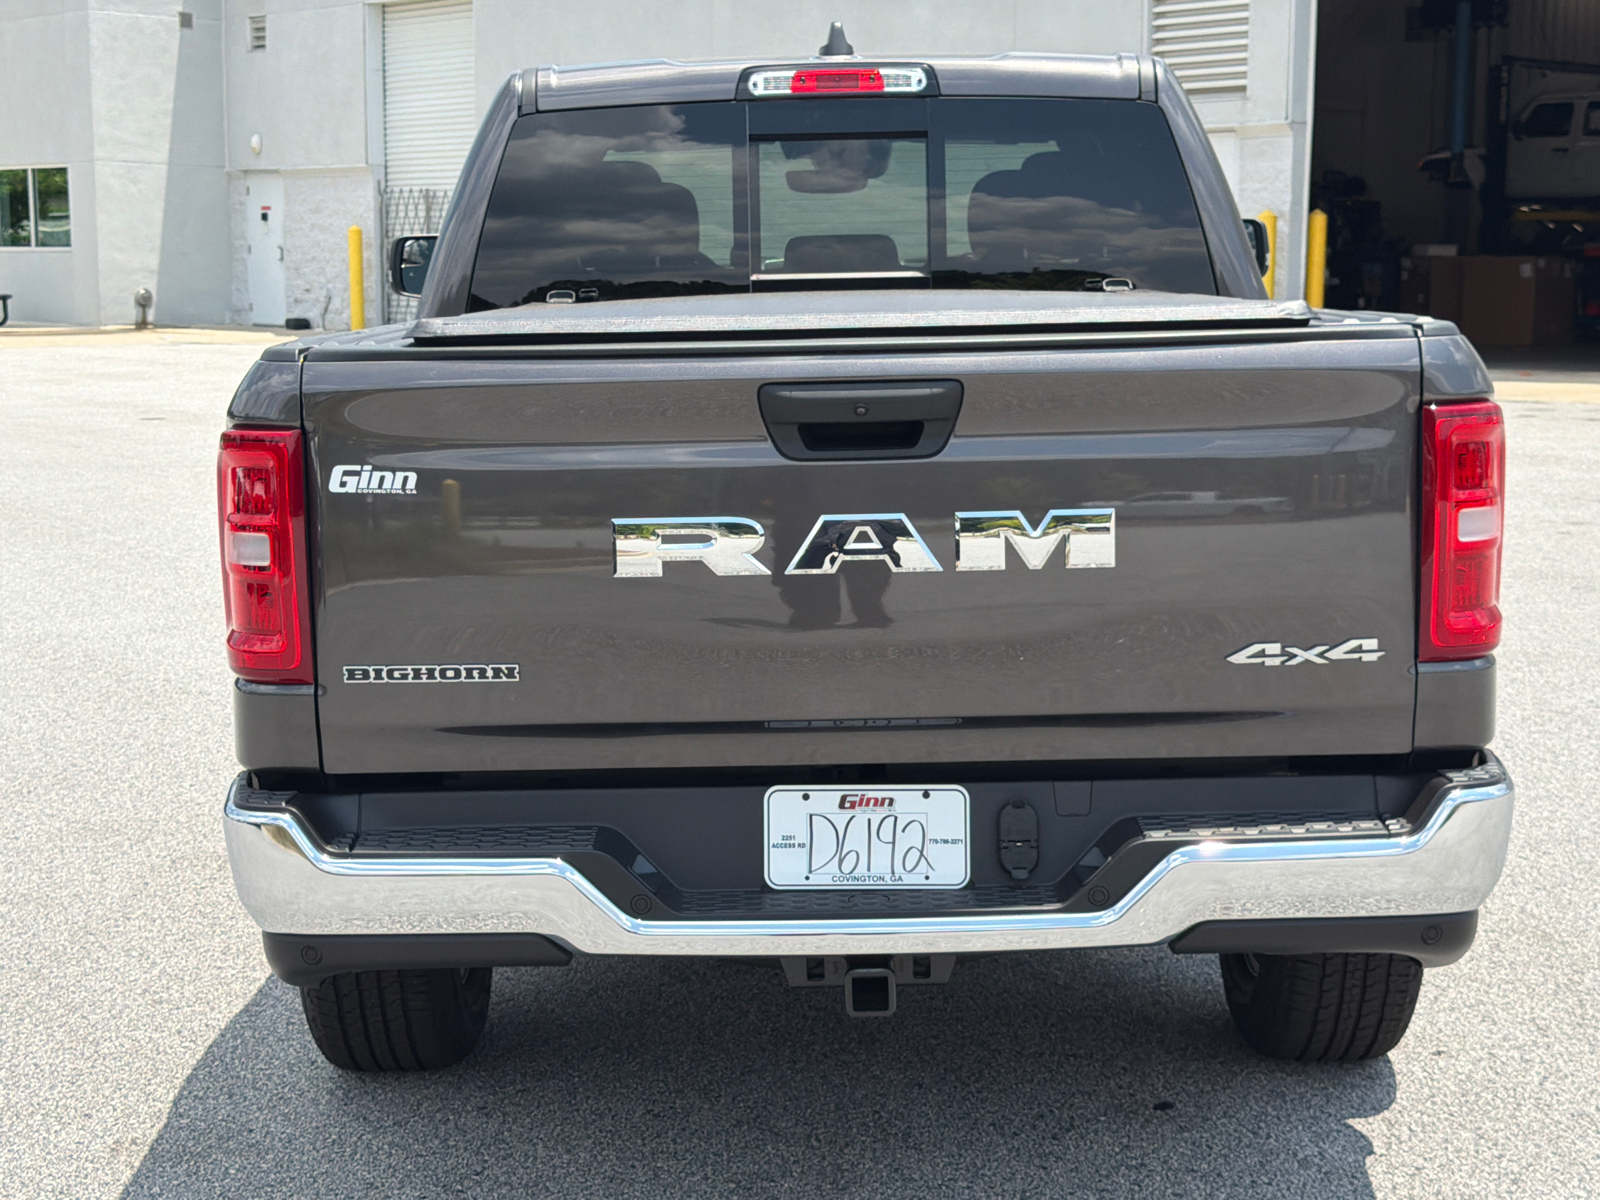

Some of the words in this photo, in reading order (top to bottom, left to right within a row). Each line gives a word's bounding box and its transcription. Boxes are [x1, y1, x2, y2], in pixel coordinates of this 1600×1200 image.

[328, 465, 418, 493] Ginn
[611, 508, 1116, 577] RAM
[343, 664, 520, 683] BIGHORN
[838, 794, 895, 810] Ginn
[809, 814, 935, 876] D6192
[831, 875, 888, 883] COVINGTON,
[889, 875, 904, 883] GA
